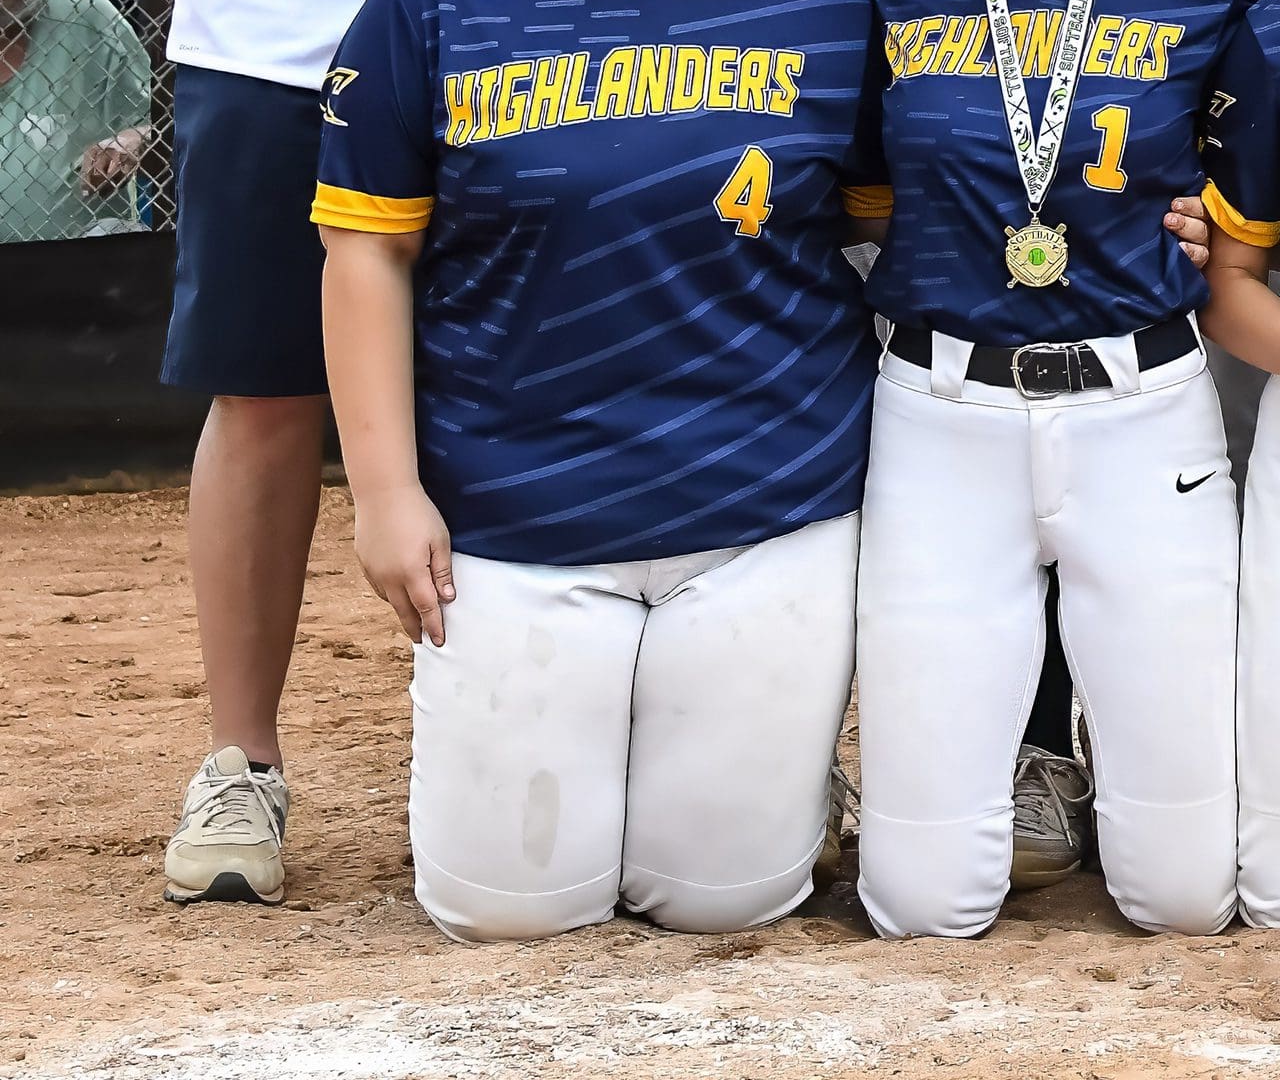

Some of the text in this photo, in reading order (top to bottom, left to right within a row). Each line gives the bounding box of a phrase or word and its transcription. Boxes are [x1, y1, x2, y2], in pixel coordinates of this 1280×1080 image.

[443, 43, 806, 148] HIGHLANDERS
[993, 15, 1022, 98] SOFTBALL
[713, 144, 775, 239] 4
[1083, 103, 1131, 193] 1
